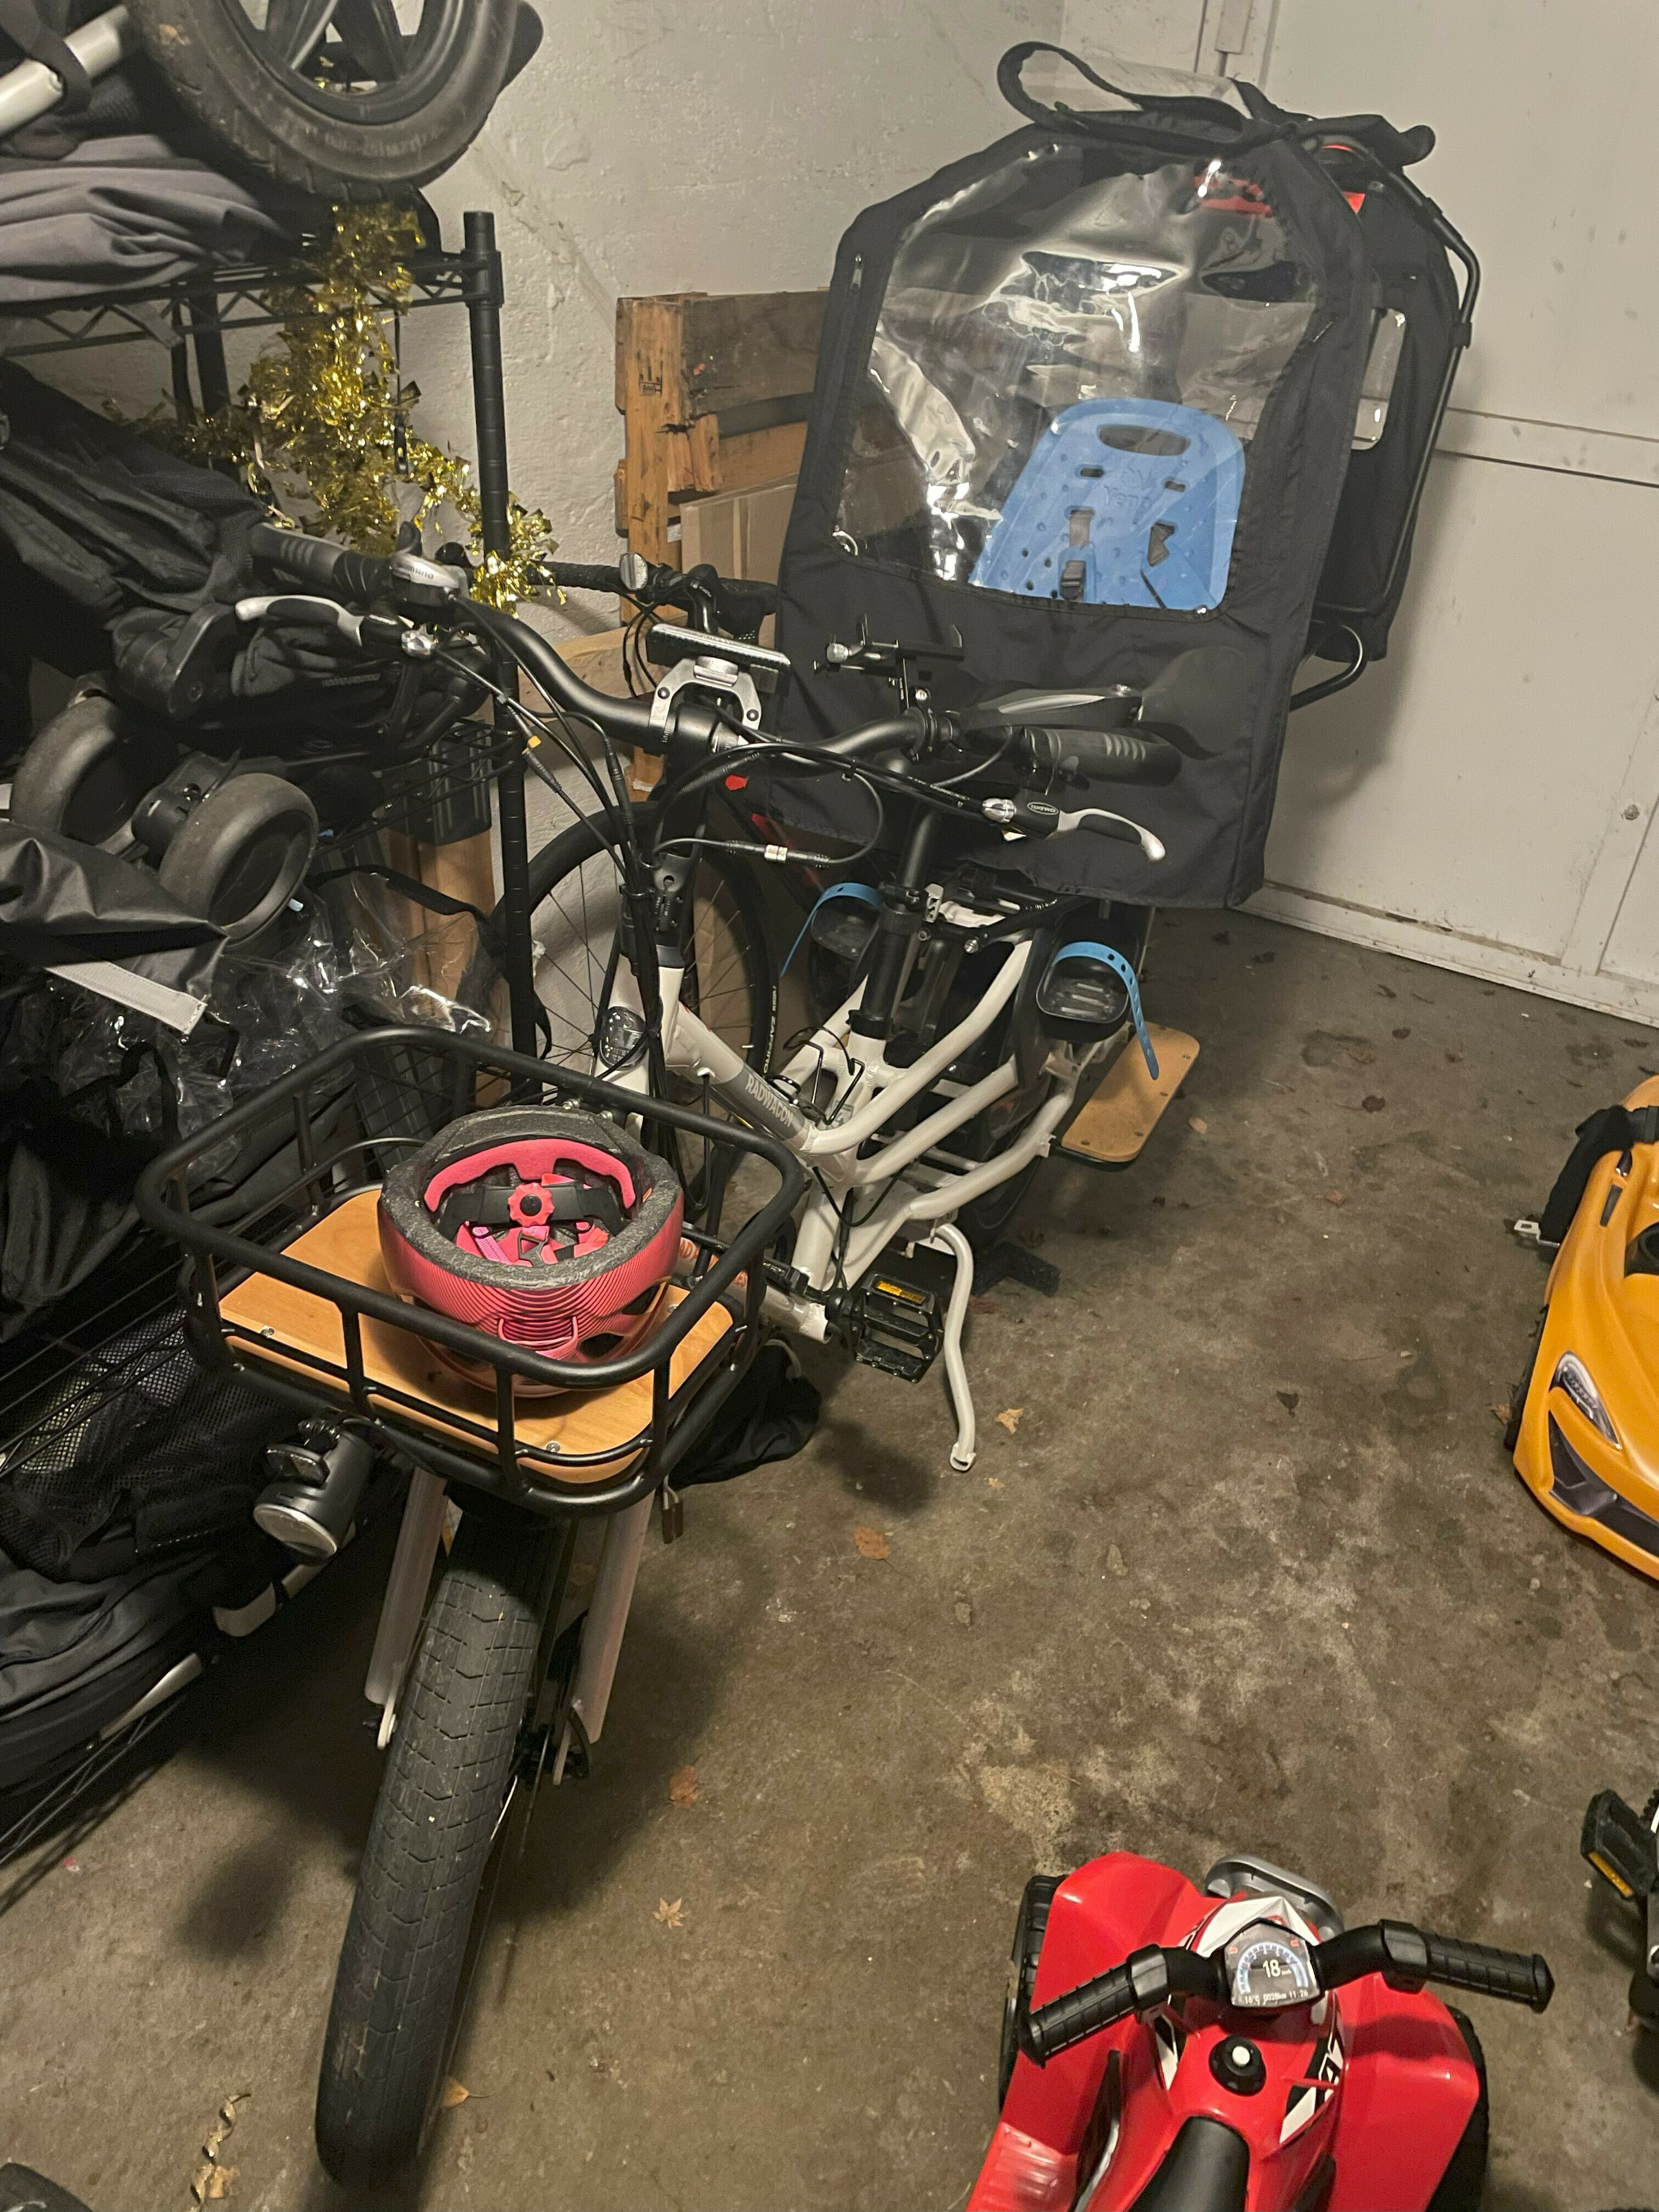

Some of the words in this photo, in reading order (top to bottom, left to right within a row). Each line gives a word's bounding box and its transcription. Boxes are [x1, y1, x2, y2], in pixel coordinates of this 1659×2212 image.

[1103, 486, 1153, 525] Yepp
[763, 1015, 776, 1074] ZAFFIRO
[745, 1074, 793, 1127] RADWAGON
[1262, 1959, 1281, 1978] 18
